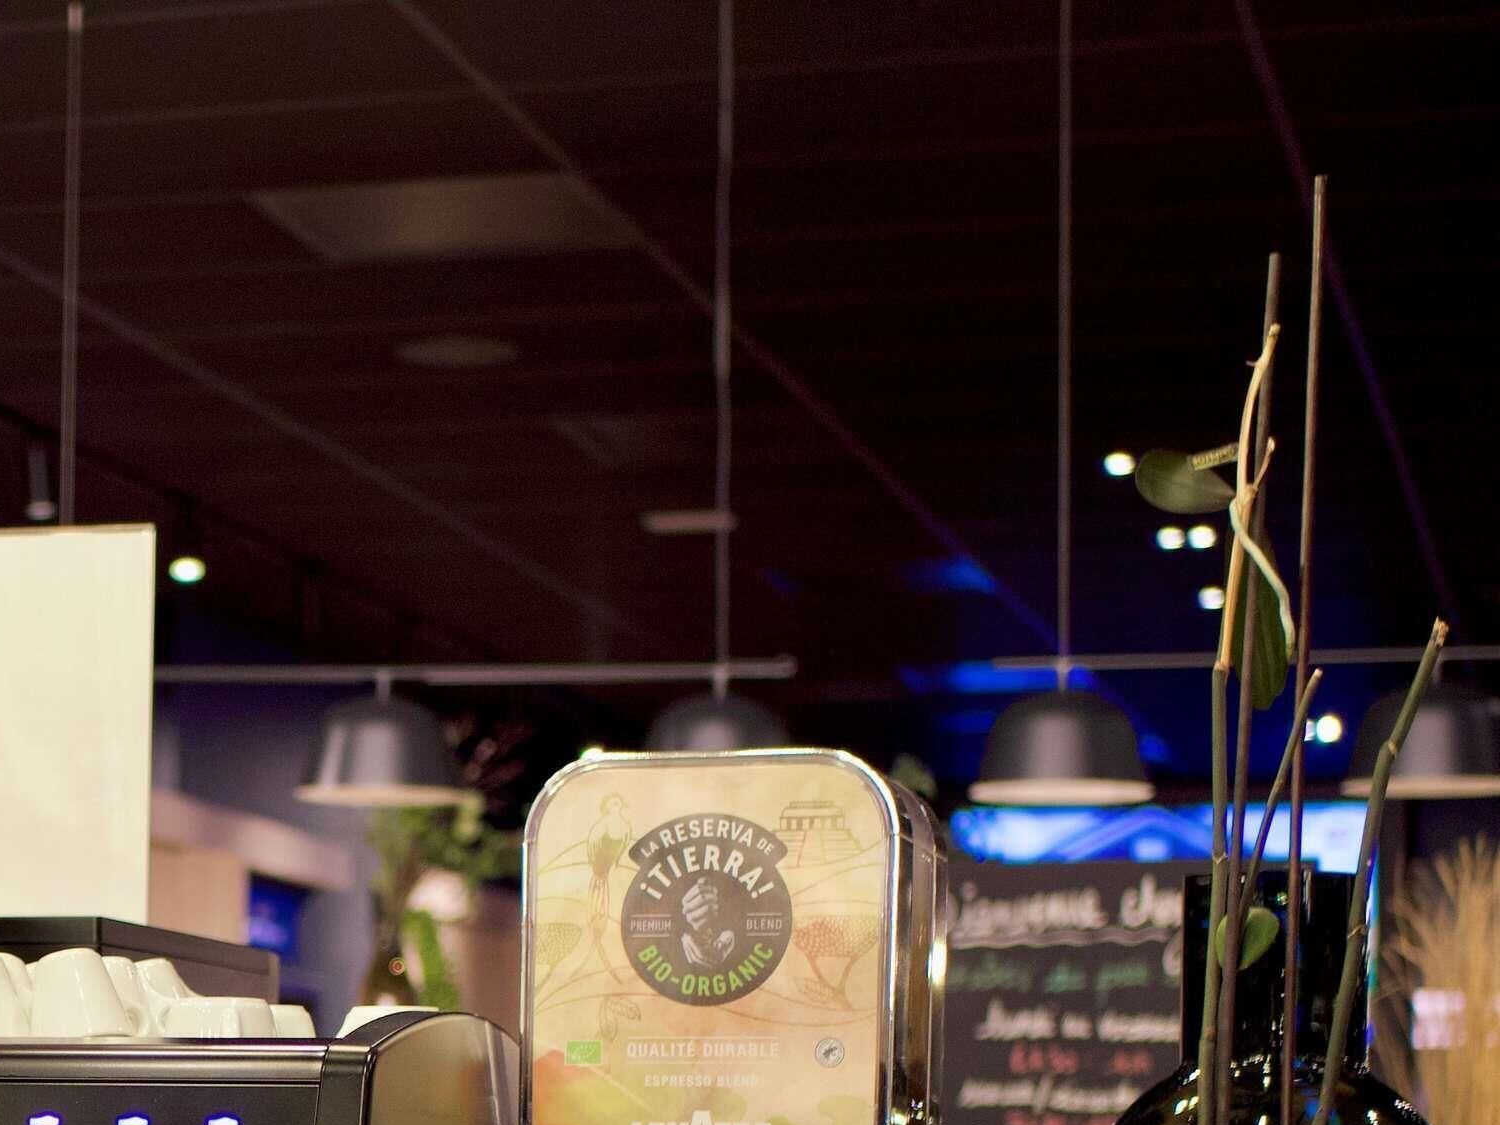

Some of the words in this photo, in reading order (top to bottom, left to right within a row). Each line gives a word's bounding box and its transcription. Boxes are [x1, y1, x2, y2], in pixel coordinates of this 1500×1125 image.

[640, 840, 660, 859] LA
[658, 817, 755, 849] RESERVA
[756, 836, 775, 857] DE
[629, 919, 673, 933] PREMIUM
[637, 942, 774, 997] BIO-ORGANIC
[626, 1039, 696, 1058] QUALITÉ
[702, 1041, 780, 1058] DURABLE
[643, 1074, 712, 1089] ESPRESSO
